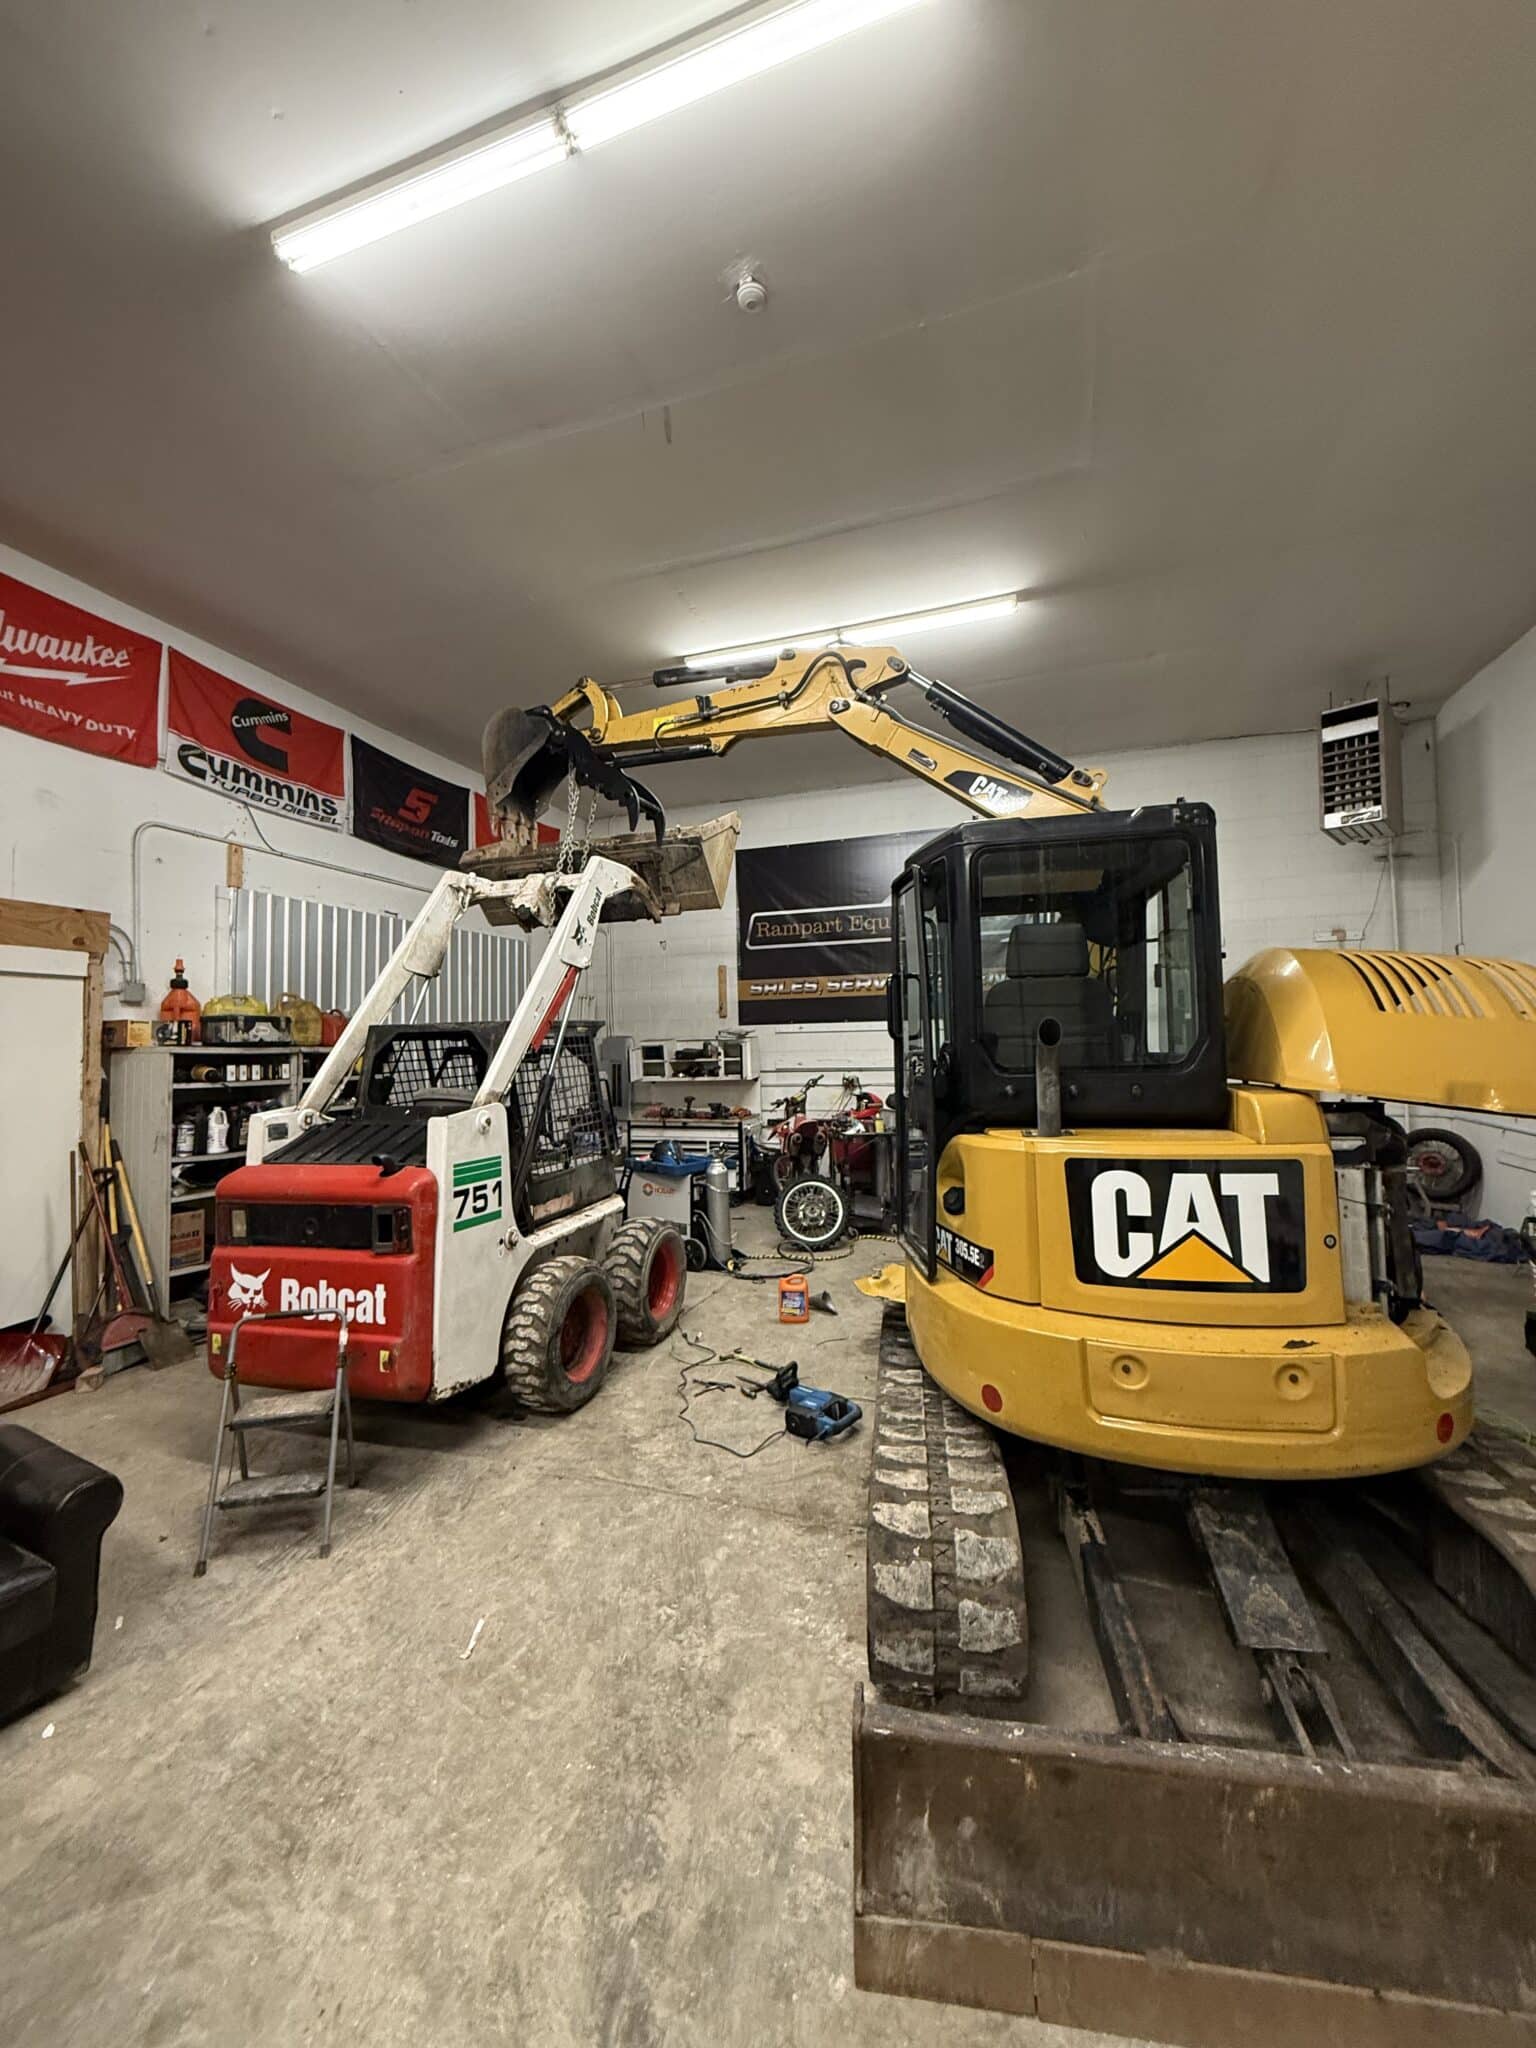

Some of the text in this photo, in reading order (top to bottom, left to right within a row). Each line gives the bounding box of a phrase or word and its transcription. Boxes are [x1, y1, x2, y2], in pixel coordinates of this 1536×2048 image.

[19, 693, 82, 727] HEAVY
[231, 711, 289, 728] Cummins
[177, 743, 338, 817] Cummins
[210, 774, 342, 826] TURBO DIESEL
[969, 775, 1009, 801] CAT
[587, 886, 603, 927] Bobcat
[756, 914, 891, 939] Rampart Equ
[827, 976, 888, 993] SERV
[453, 1180, 502, 1220] 751
[1091, 1170, 1280, 1284] CAT
[280, 1278, 387, 1325] Bobcat
